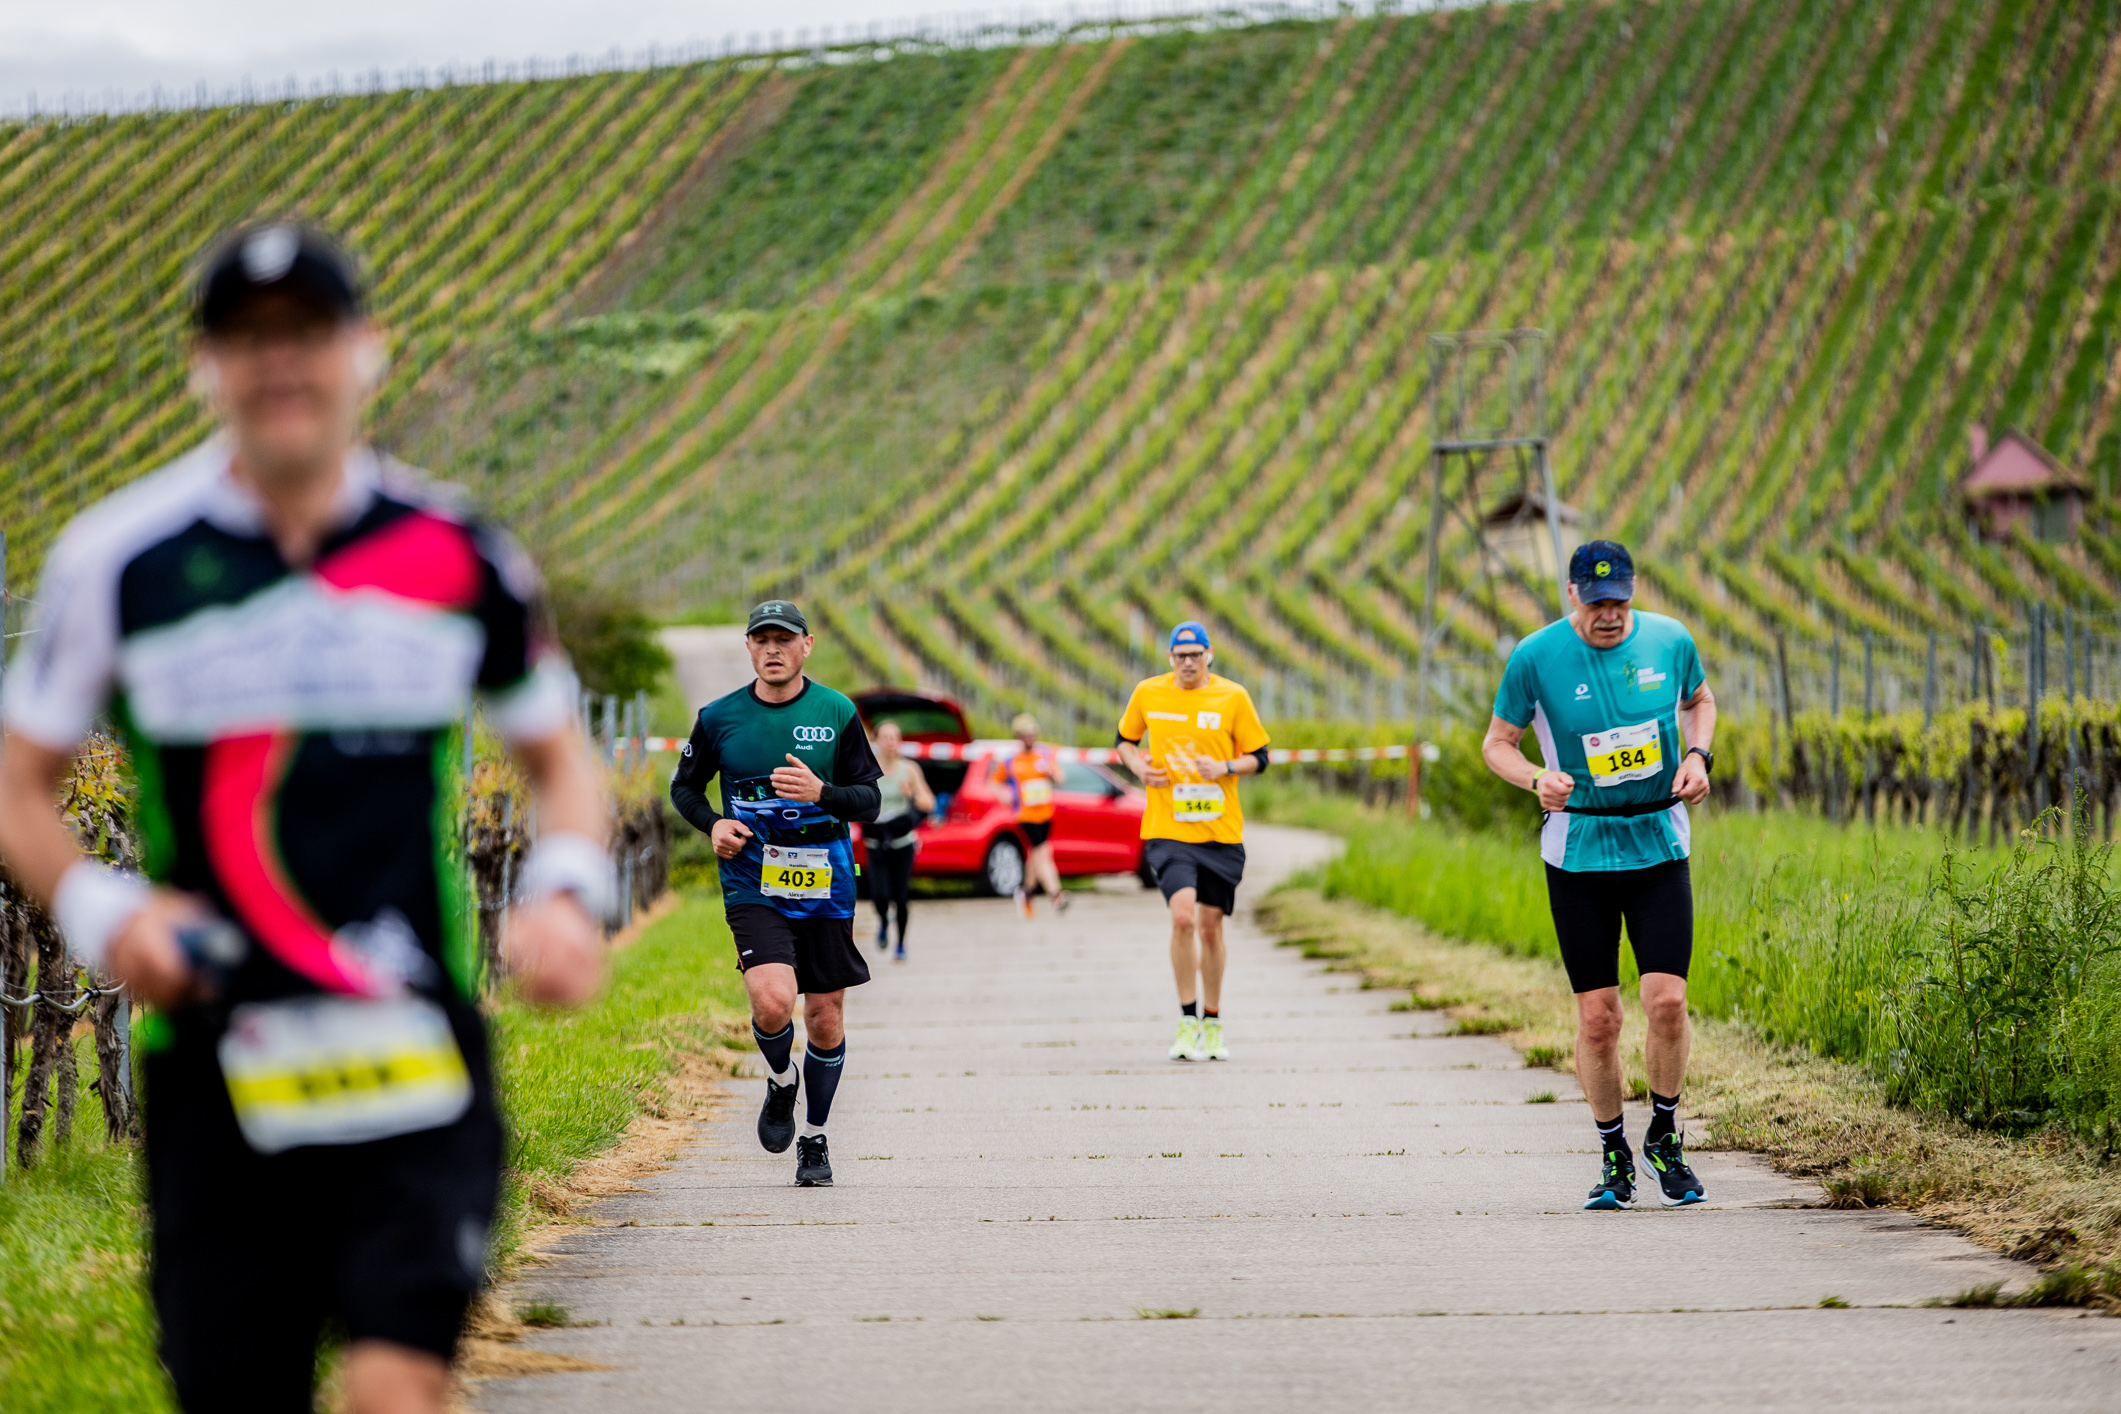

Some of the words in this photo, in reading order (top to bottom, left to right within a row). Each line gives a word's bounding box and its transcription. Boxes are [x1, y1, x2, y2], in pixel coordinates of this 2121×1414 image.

[795, 743, 814, 751] Audi
[1608, 749, 1646, 772] 184
[1185, 801, 1212, 812] 546
[778, 870, 816, 887] 403
